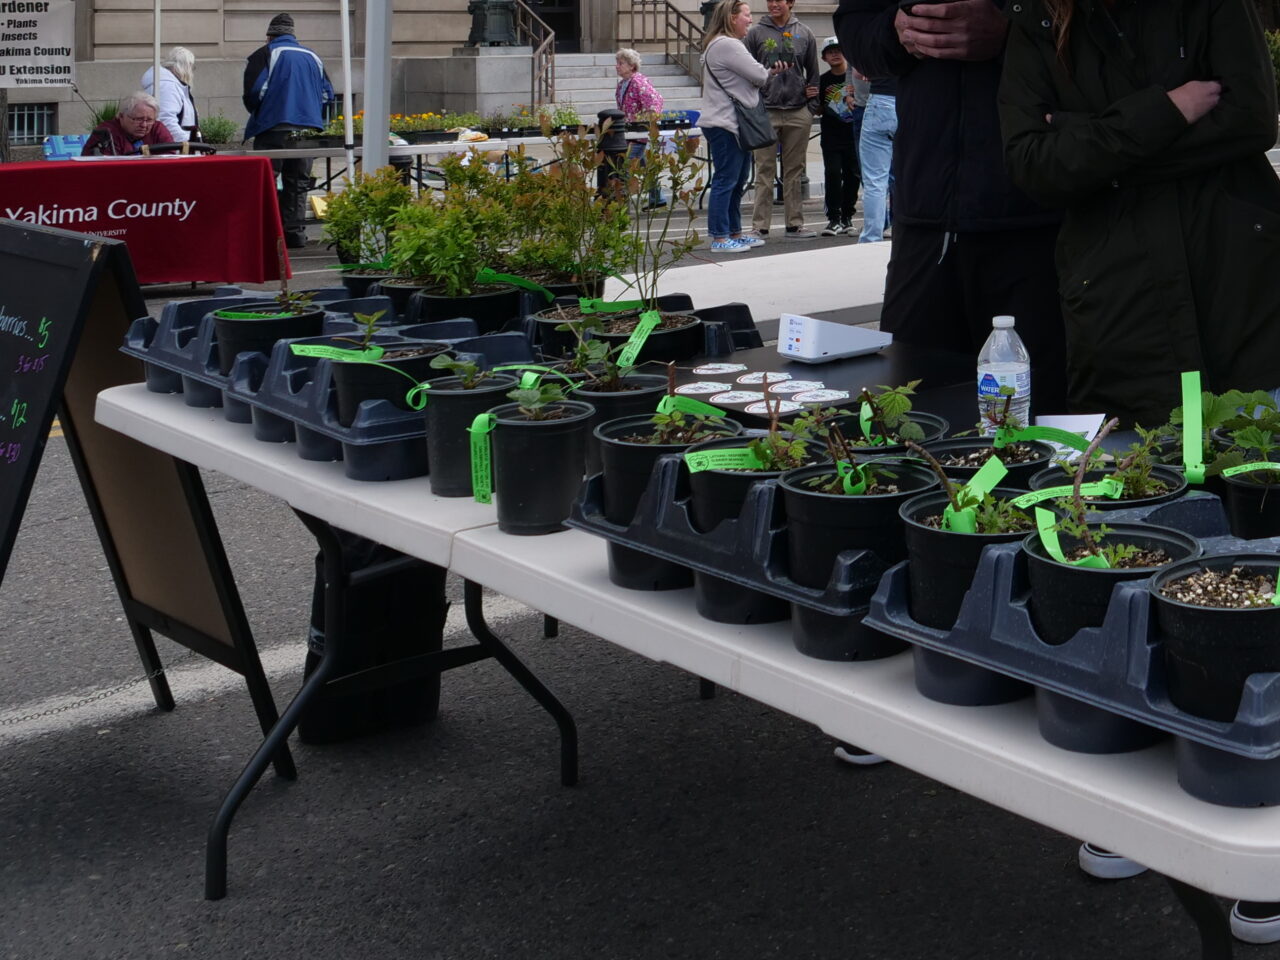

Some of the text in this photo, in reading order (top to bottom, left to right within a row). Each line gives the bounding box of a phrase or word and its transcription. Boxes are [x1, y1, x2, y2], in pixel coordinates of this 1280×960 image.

[0, 0, 49, 13] rdener
[7, 19, 38, 28] Plants
[2, 32, 38, 41] Insects
[33, 46, 71, 57] County
[9, 64, 71, 75] Extension
[5, 198, 197, 225] Yakima County
